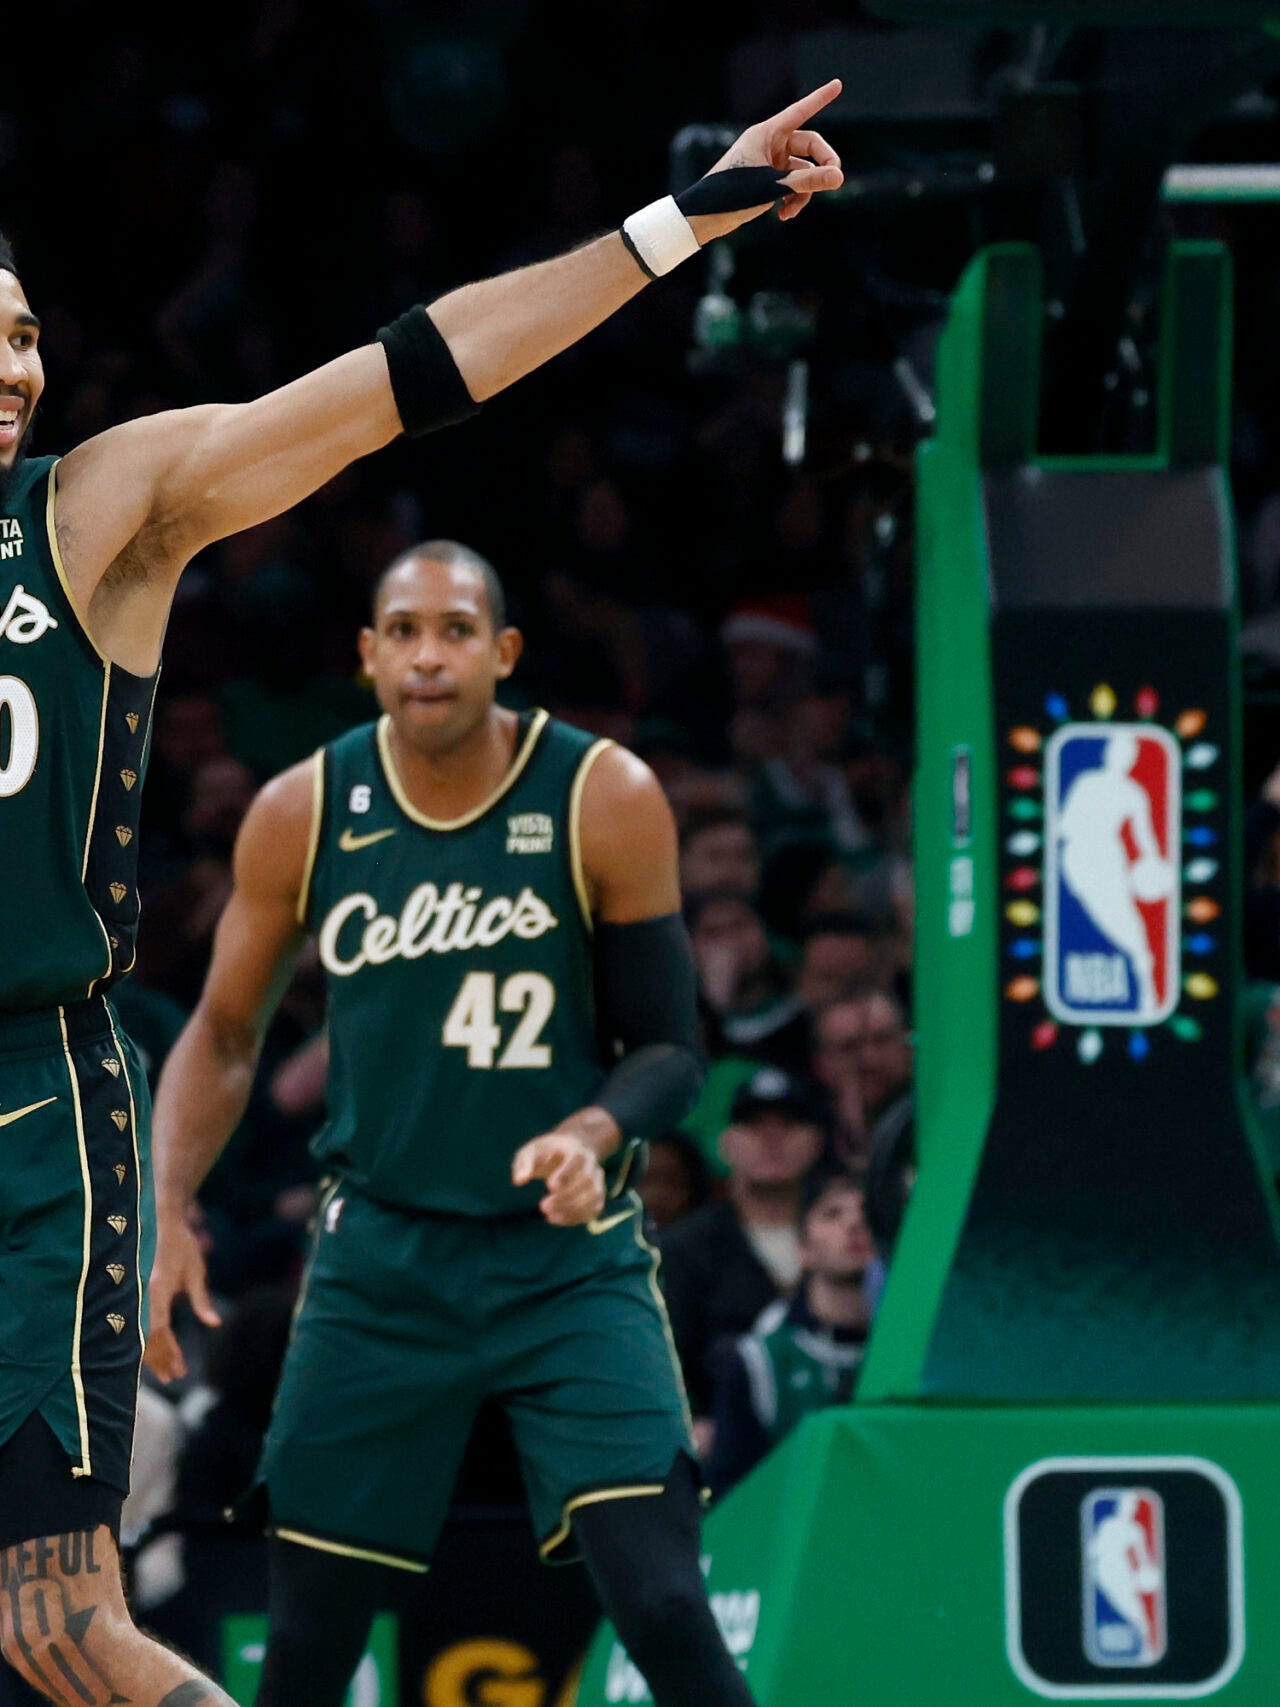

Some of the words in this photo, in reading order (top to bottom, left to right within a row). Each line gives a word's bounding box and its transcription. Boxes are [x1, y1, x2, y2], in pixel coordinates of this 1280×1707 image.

[349, 784, 371, 814] 6
[319, 882, 559, 977] Celtics
[442, 970, 556, 1071] 42
